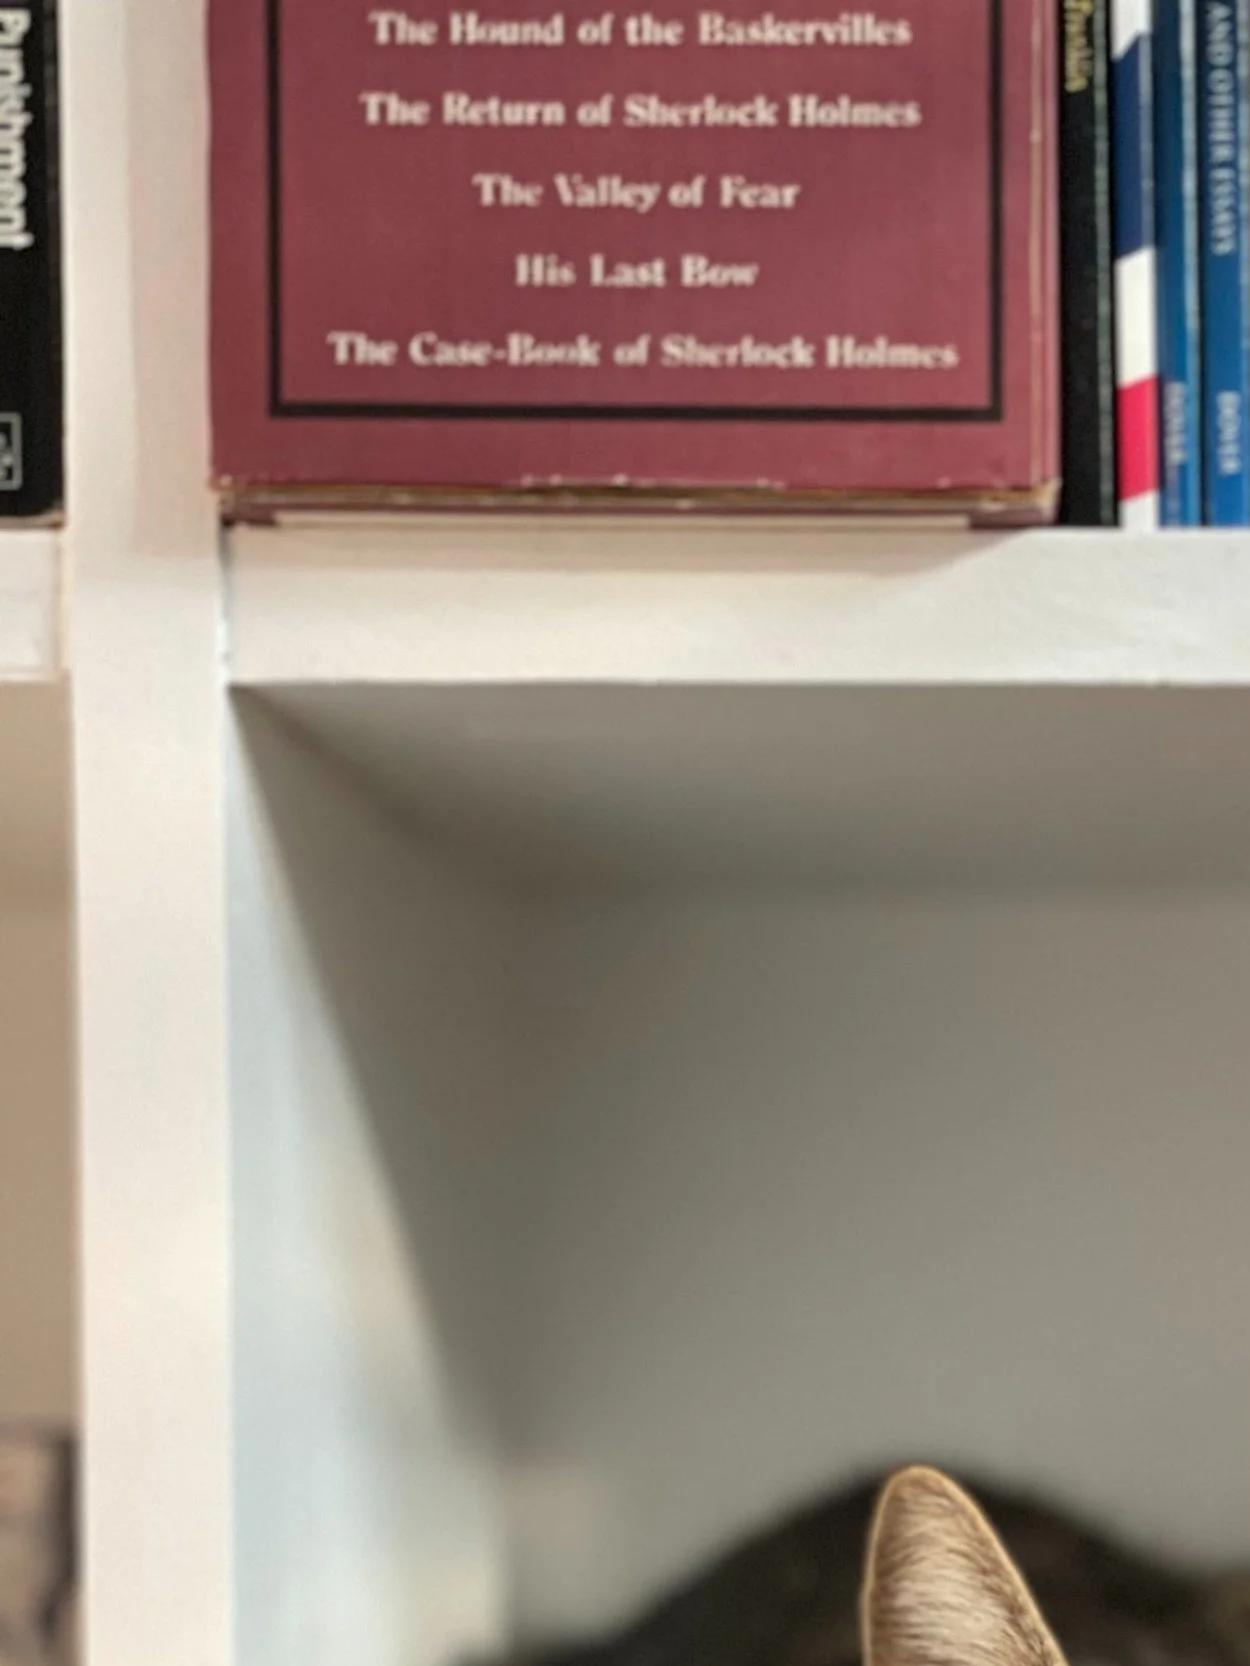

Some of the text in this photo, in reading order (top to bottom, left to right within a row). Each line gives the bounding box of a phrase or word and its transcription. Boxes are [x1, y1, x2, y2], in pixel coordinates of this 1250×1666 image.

[369, 11, 913, 47] The Hound of the Baskervilles
[361, 91, 922, 128] The Return of Sherlock Holmes
[1205, 1, 1237, 256] AND OTHER ESSAYS
[472, 172, 801, 214] The Valley of Fear
[515, 253, 759, 288] His Last Bow
[329, 332, 960, 369] The Case-Book of Sherlock Holmes
